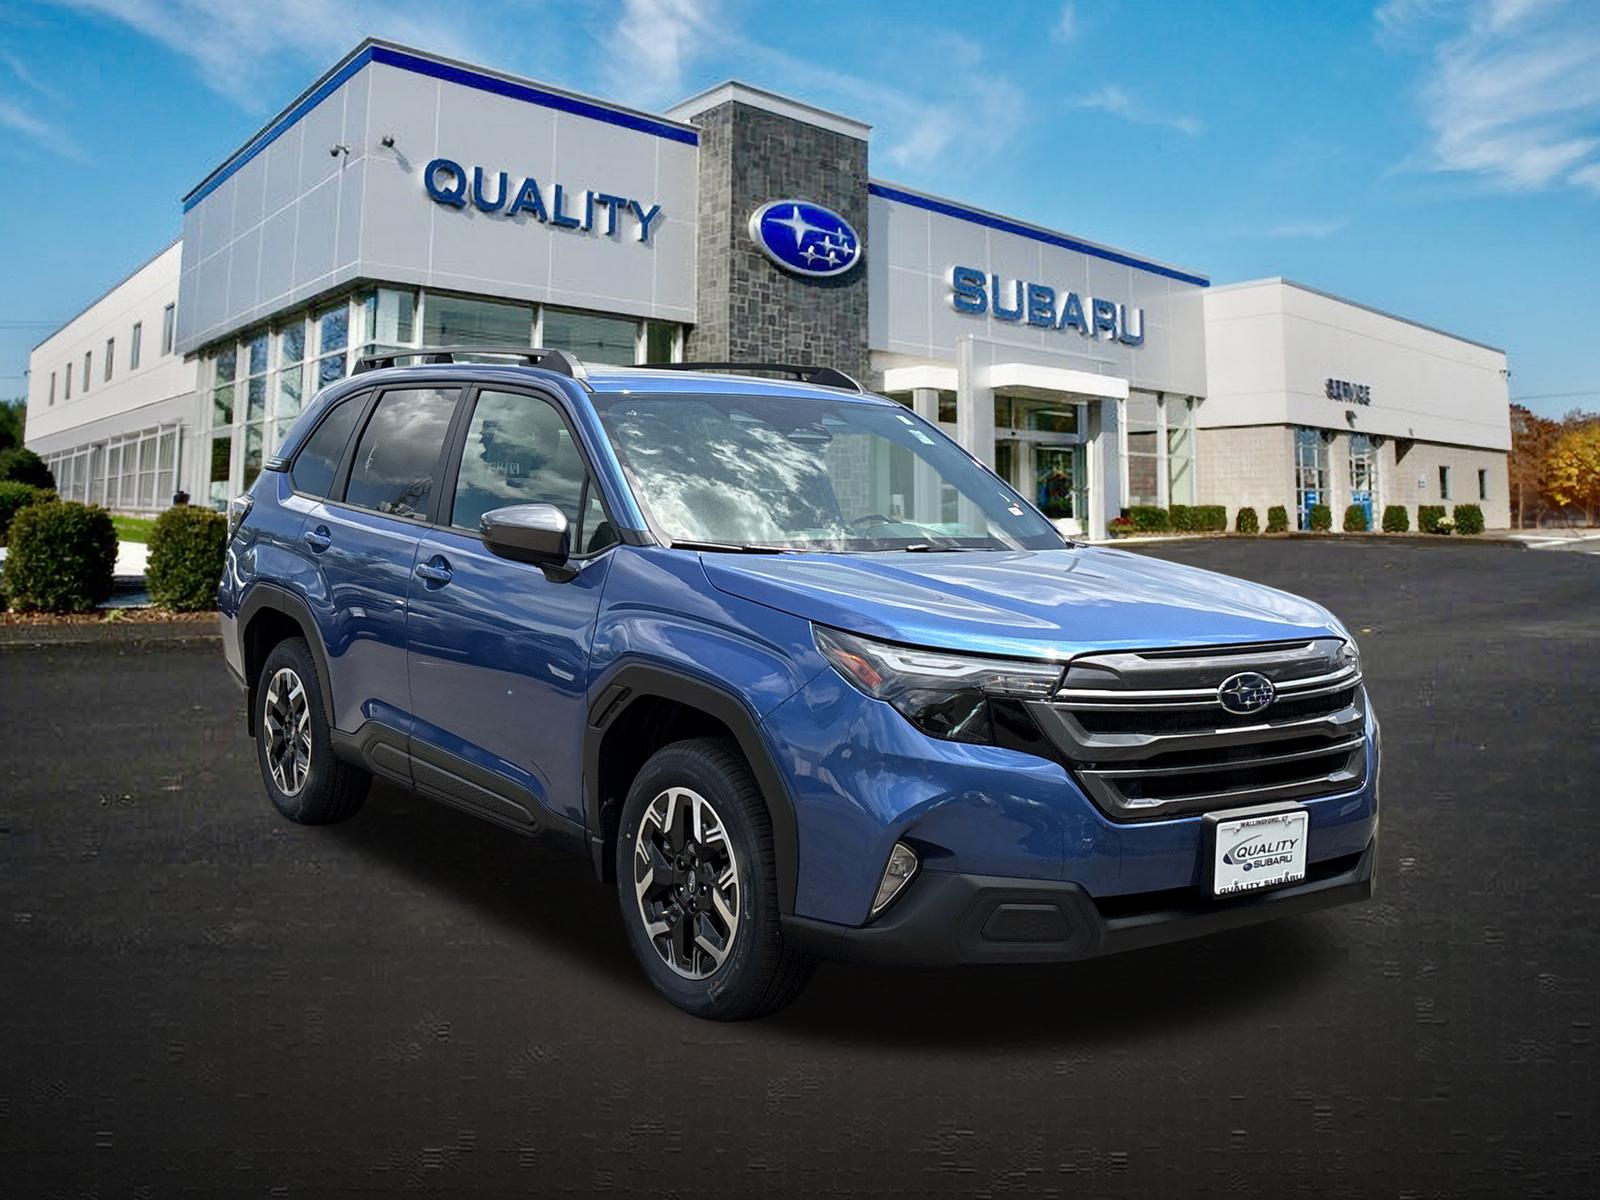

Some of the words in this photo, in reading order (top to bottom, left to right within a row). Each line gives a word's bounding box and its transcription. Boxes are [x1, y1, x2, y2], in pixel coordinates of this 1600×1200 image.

[424, 158, 662, 243] QUALITY
[951, 265, 1146, 347] SUBARU
[1236, 838, 1299, 859] QUALITY
[1253, 854, 1293, 869] SUBARU
[1220, 881, 1261, 895] QUALITY
[1264, 873, 1303, 886] SUBARU
